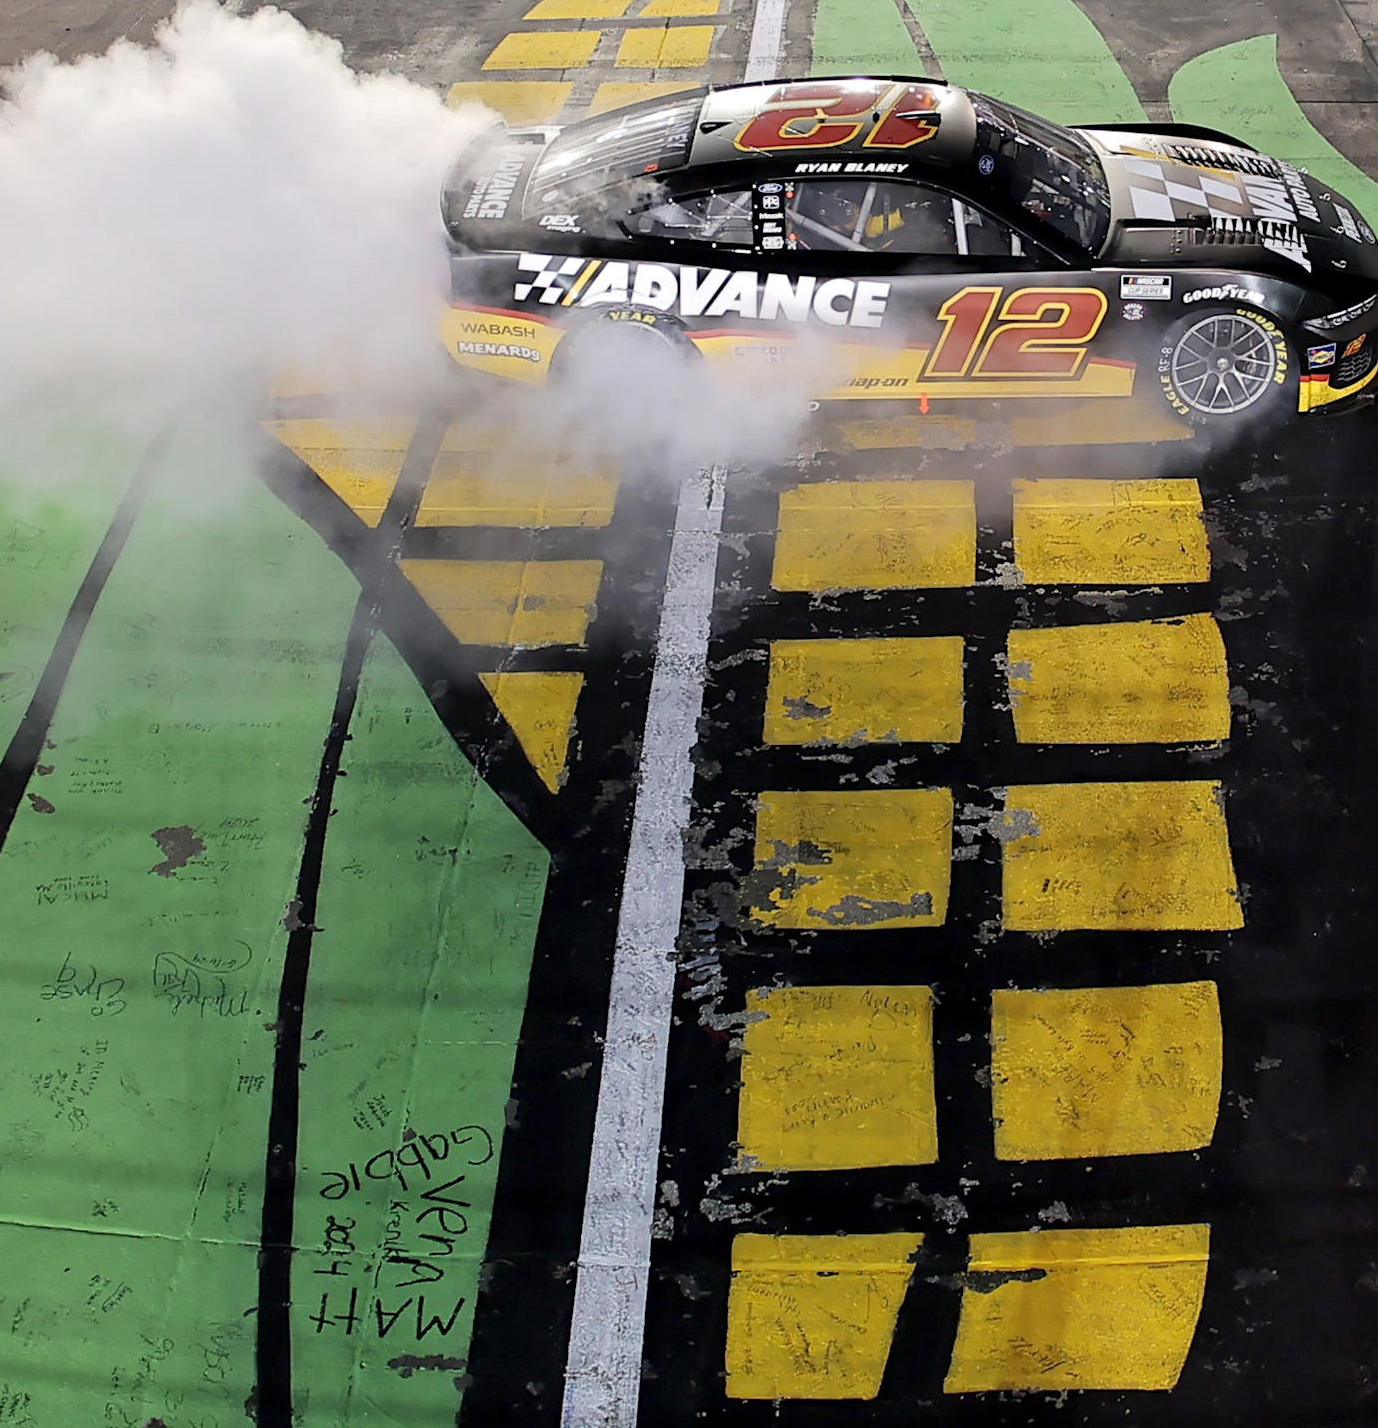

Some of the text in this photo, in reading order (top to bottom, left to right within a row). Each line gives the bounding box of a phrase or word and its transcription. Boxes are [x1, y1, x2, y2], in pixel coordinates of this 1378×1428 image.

[795, 162, 909, 173] RYAN BLANEY
[539, 215, 580, 227] DEX
[578, 262, 893, 329] ADVANCE
[1183, 284, 1265, 304] GOODYEAR
[460, 322, 536, 340] WABASH
[917, 287, 1108, 383] 12
[457, 341, 541, 362] MENARDS
[841, 376, 909, 389] nap-on
[1160, 375, 1189, 416] EAGLE
